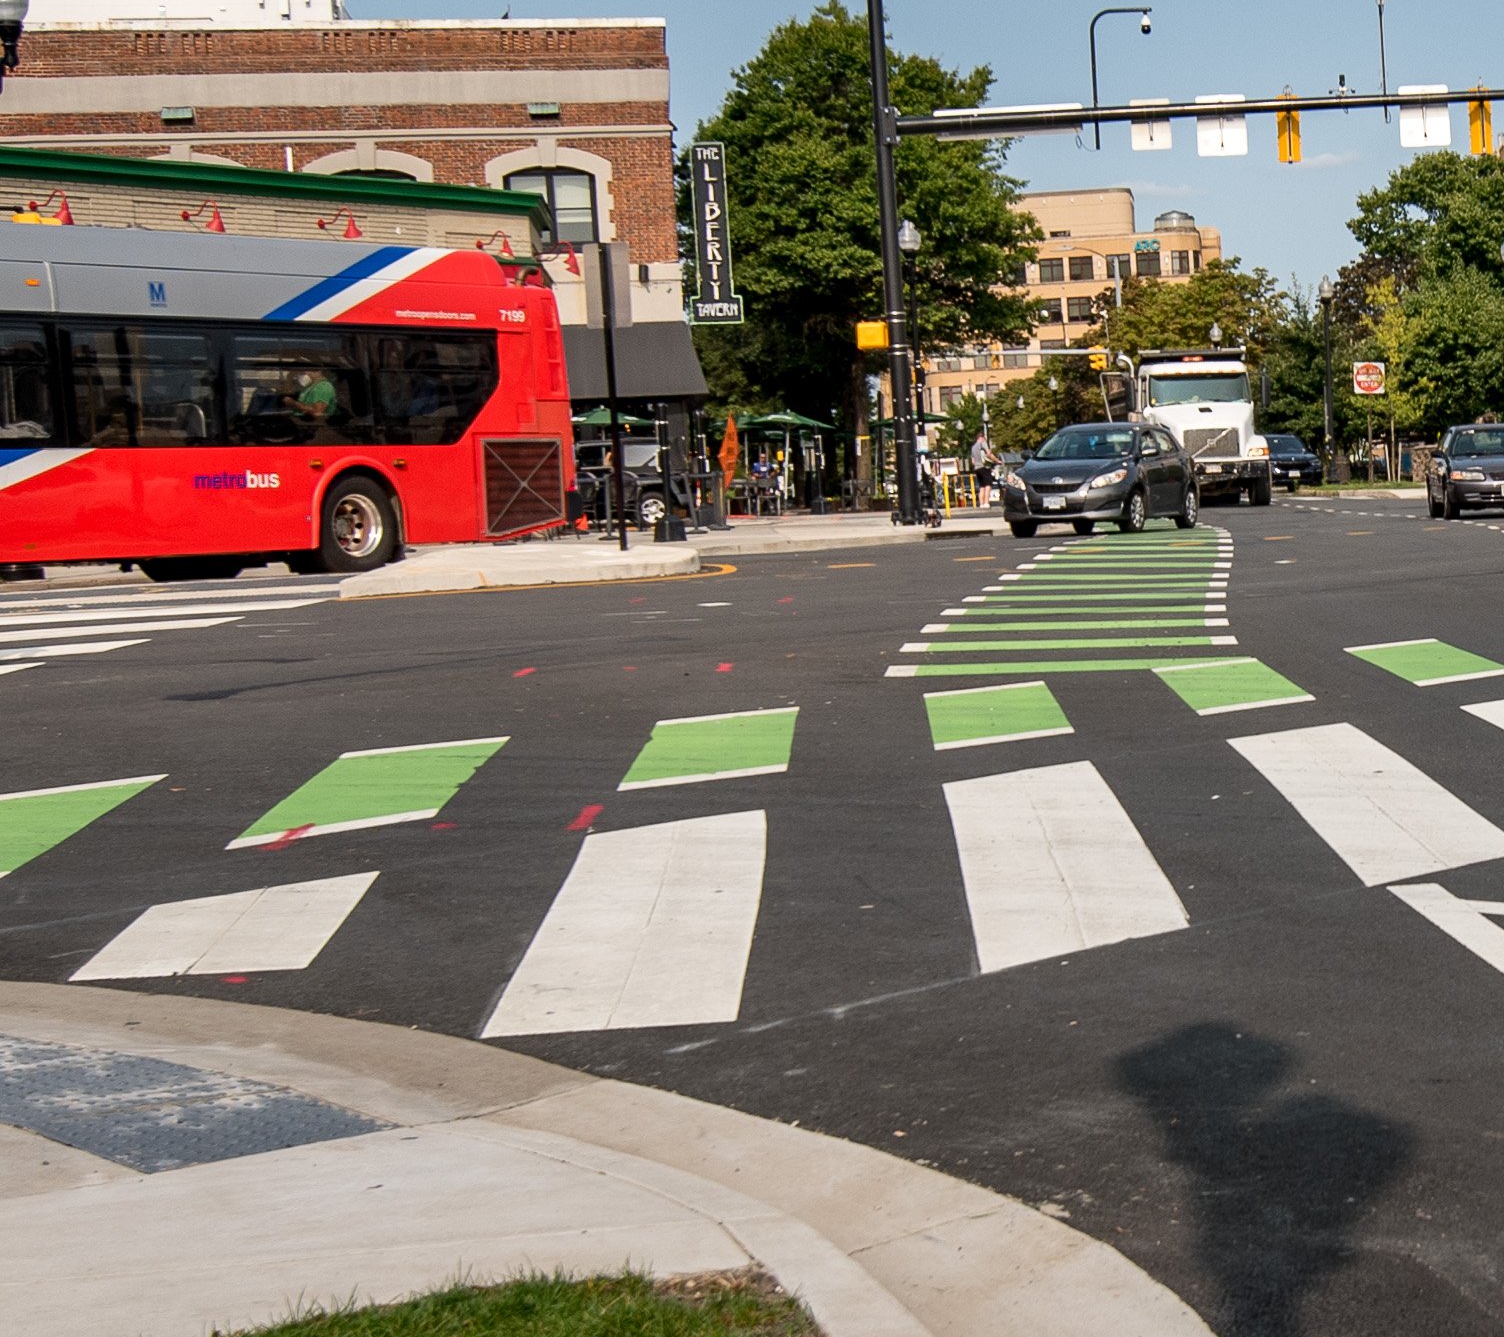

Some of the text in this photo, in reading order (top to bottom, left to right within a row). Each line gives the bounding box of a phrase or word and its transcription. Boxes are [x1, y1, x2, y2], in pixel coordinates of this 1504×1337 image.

[695, 147, 719, 160] THE
[703, 162, 723, 301] LIBERTY
[498, 309, 526, 323] 7199
[696, 302, 739, 318] TAVERN
[193, 469, 281, 489] metrobus
